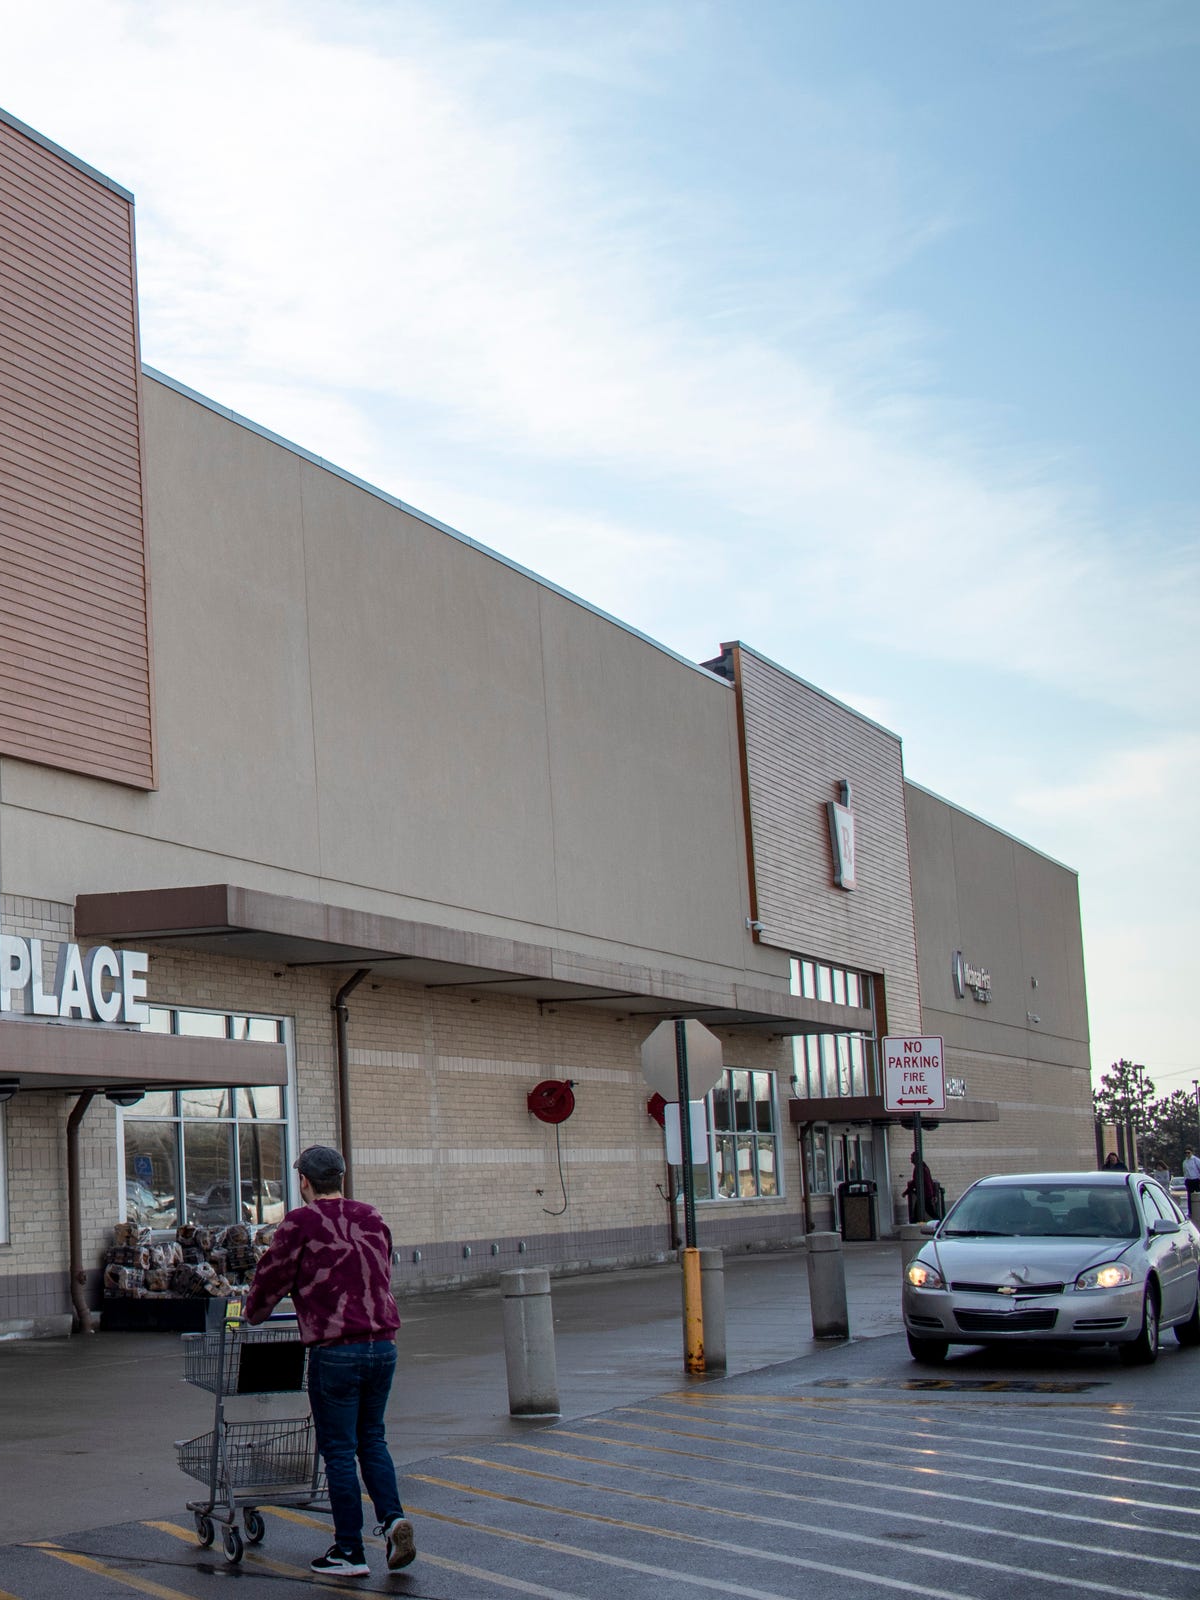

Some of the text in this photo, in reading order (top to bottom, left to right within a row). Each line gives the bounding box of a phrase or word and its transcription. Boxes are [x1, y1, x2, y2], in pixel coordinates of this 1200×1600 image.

[903, 1041, 922, 1053] NO
[888, 1056, 939, 1068] PARKING
[903, 1072, 925, 1081] FIRE
[901, 1085, 928, 1095] LANE
